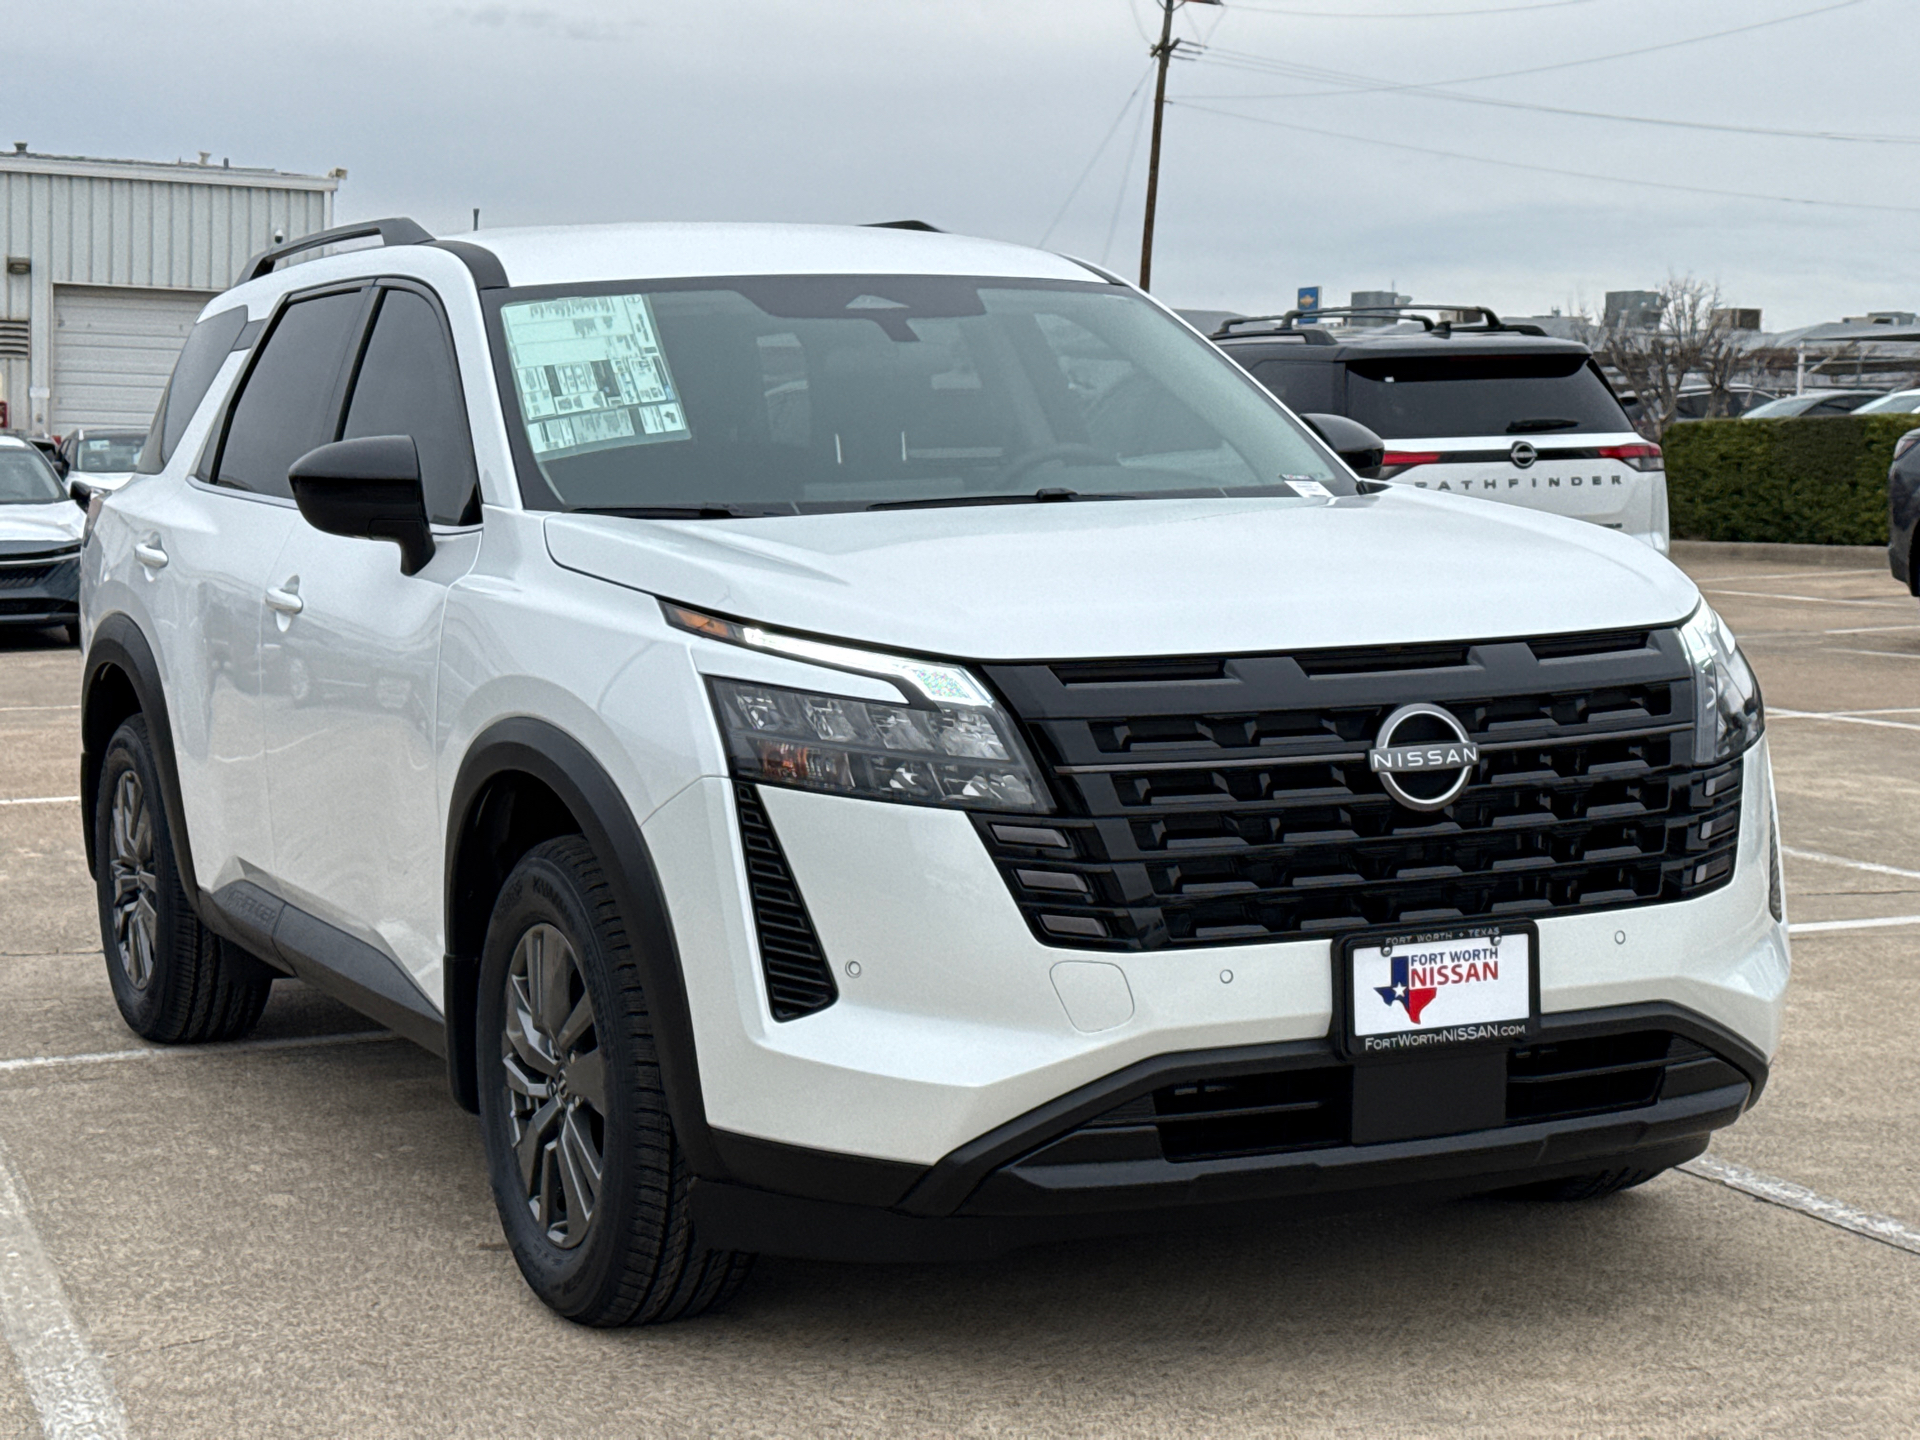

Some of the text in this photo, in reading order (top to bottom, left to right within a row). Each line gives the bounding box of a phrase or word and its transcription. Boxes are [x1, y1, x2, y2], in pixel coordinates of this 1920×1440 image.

[1414, 475, 1622, 491] PATHFINDER
[1373, 747, 1478, 768] NISSAN
[1385, 926, 1500, 946] FORT WORTH TEXAS
[1410, 947, 1499, 967] FORT WORTH
[1410, 961, 1499, 988] NISSAN
